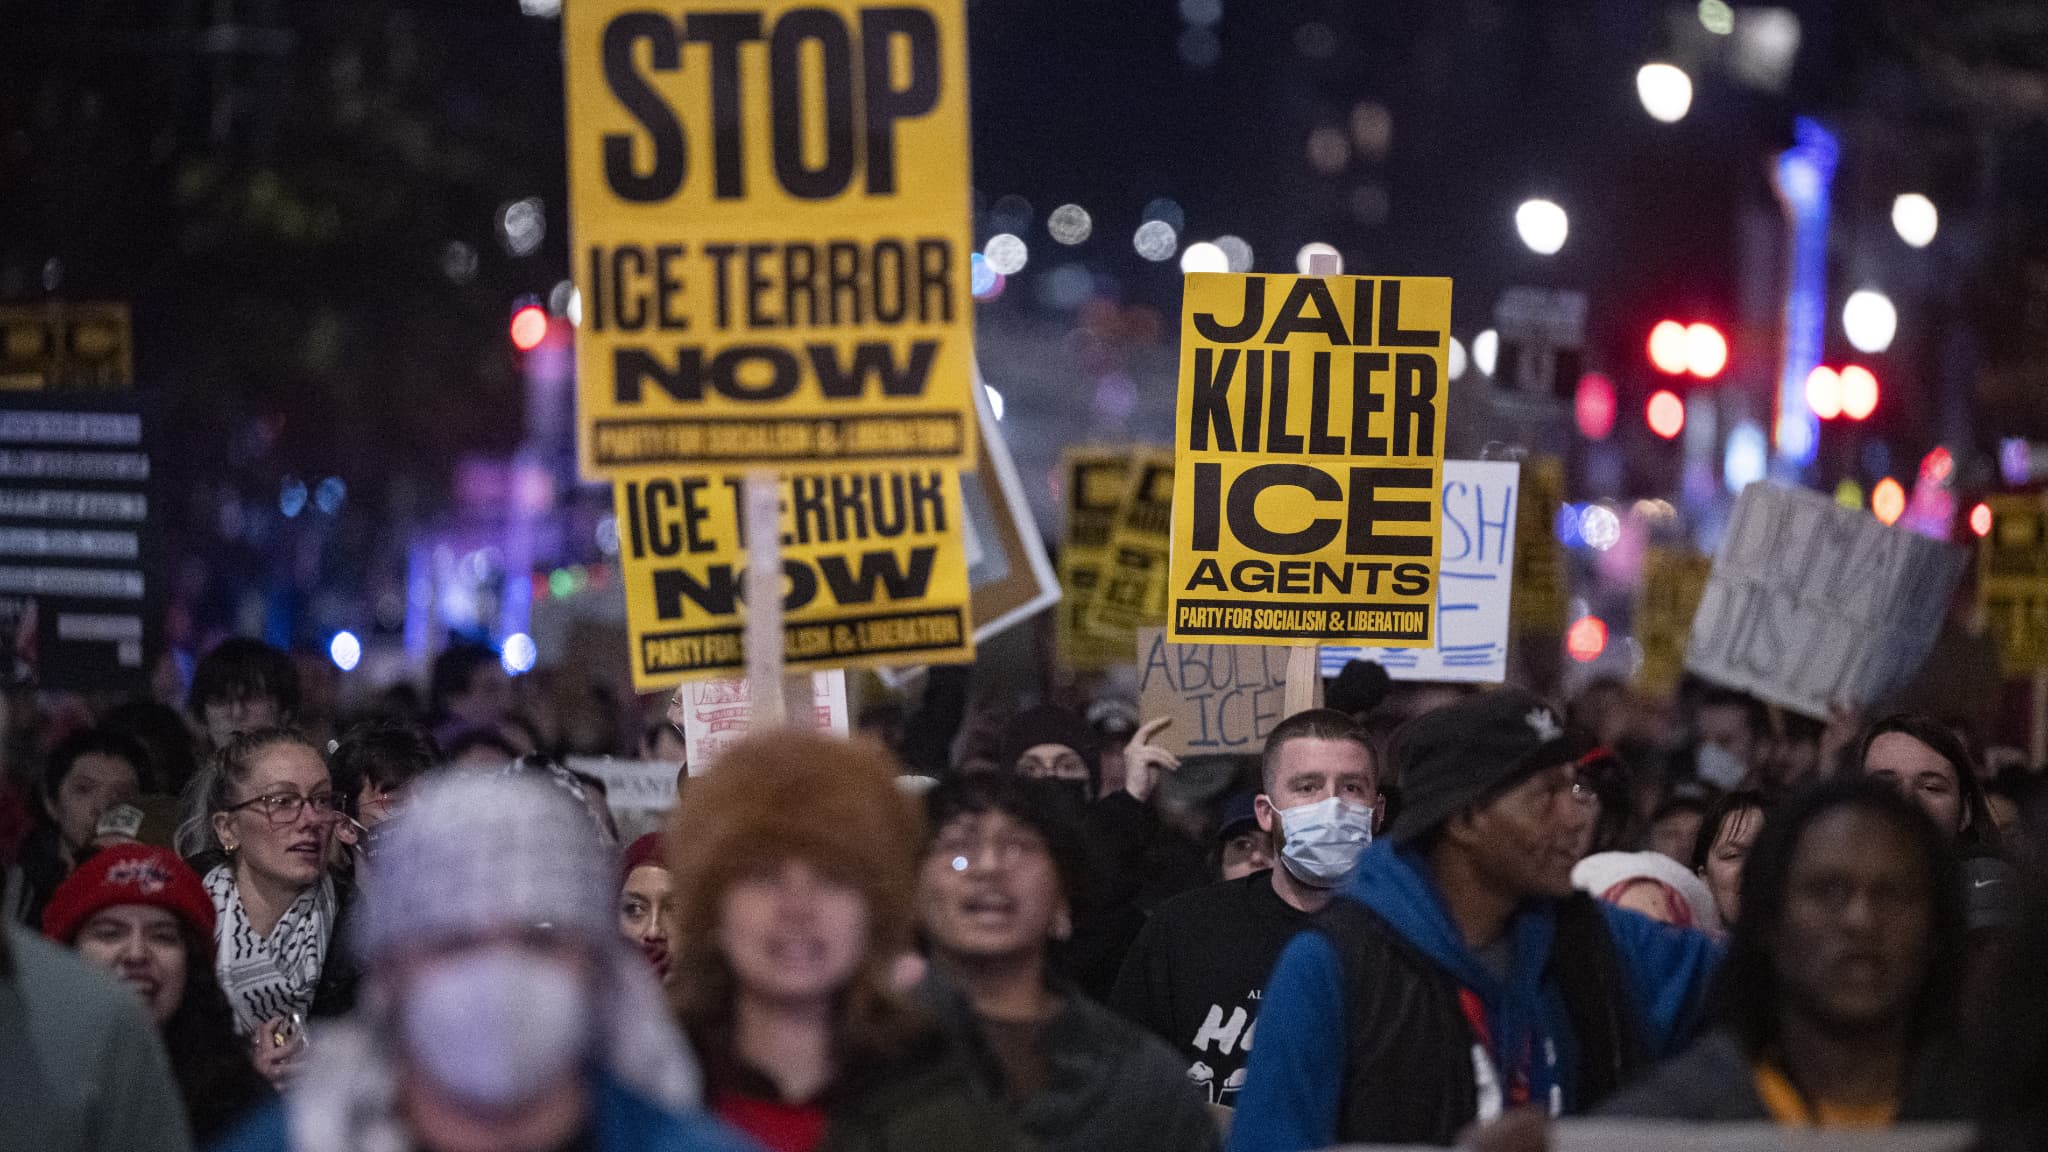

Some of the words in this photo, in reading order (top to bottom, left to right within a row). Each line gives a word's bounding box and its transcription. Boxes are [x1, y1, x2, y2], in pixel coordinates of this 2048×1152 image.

[602, 8, 942, 205] STOP
[590, 245, 688, 333] ICE
[702, 238, 955, 330] TERROR
[1193, 276, 1440, 347] JAIL
[613, 340, 940, 403] NOW
[1190, 348, 1437, 456] KILLER
[626, 478, 715, 558] ICE
[723, 471, 947, 547] TRROR
[1192, 462, 1433, 556] ICE
[652, 547, 937, 620] NOW
[1185, 558, 1430, 595] AGENTS
[1179, 607, 1224, 629] PARTY
[1225, 608, 1252, 630] FOR
[1254, 609, 1326, 632] SOCIALISM
[1328, 611, 1345, 632] &
[1347, 610, 1423, 633] LIBERATION
[1186, 688, 1277, 746] ICE
